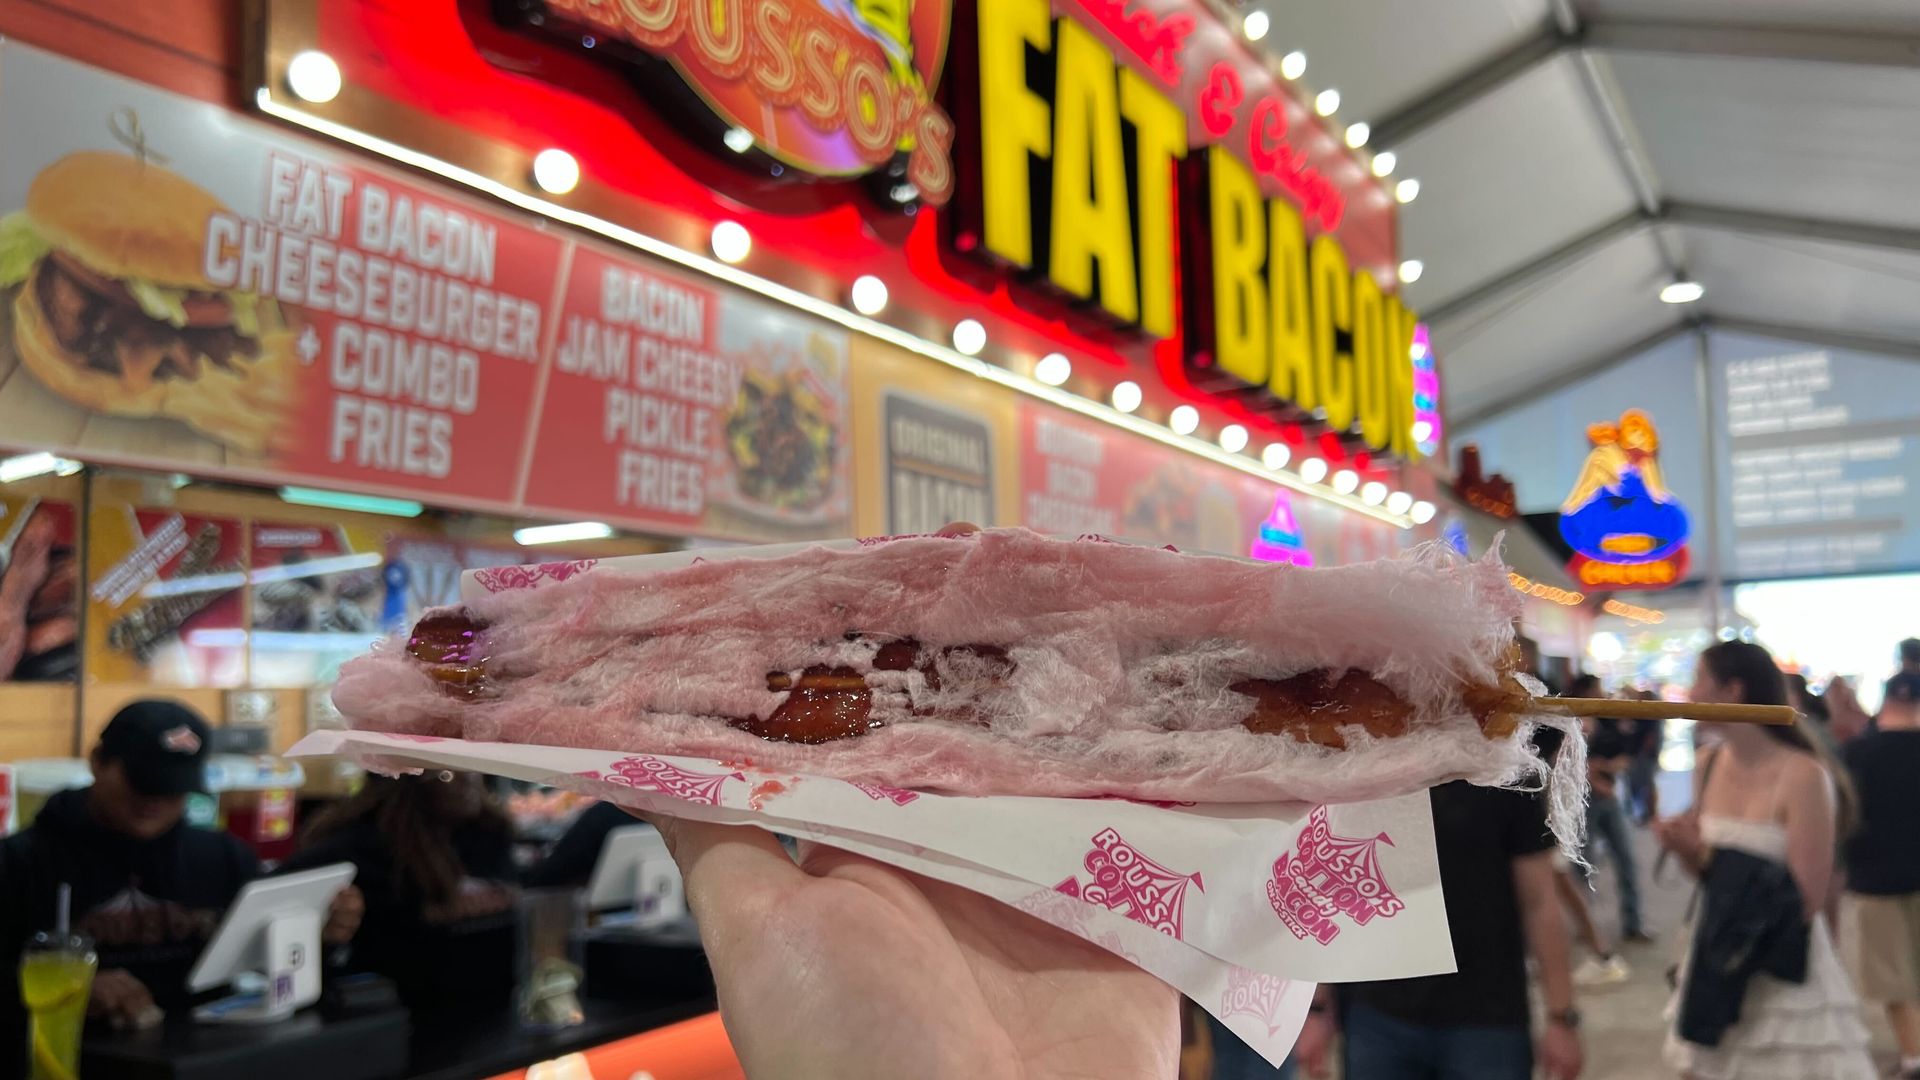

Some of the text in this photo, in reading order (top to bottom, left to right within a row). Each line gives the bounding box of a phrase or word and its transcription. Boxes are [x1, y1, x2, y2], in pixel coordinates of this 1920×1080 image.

[590, 0, 953, 198] USSO'S
[267, 155, 498, 284] FAT BACON
[977, 0, 1188, 339] FAT
[1208, 143, 1420, 464] BACON
[204, 213, 541, 363] CHEESEBURGER
[602, 266, 704, 344] BACON
[330, 320, 480, 415] COMBO
[556, 313, 630, 383] JAM
[329, 393, 452, 479] FRIES
[604, 387, 711, 458] PICKLE
[616, 451, 704, 515] FRIES
[1289, 857, 1340, 918] Candy
[1310, 804, 1405, 918] ROUSSO'S
